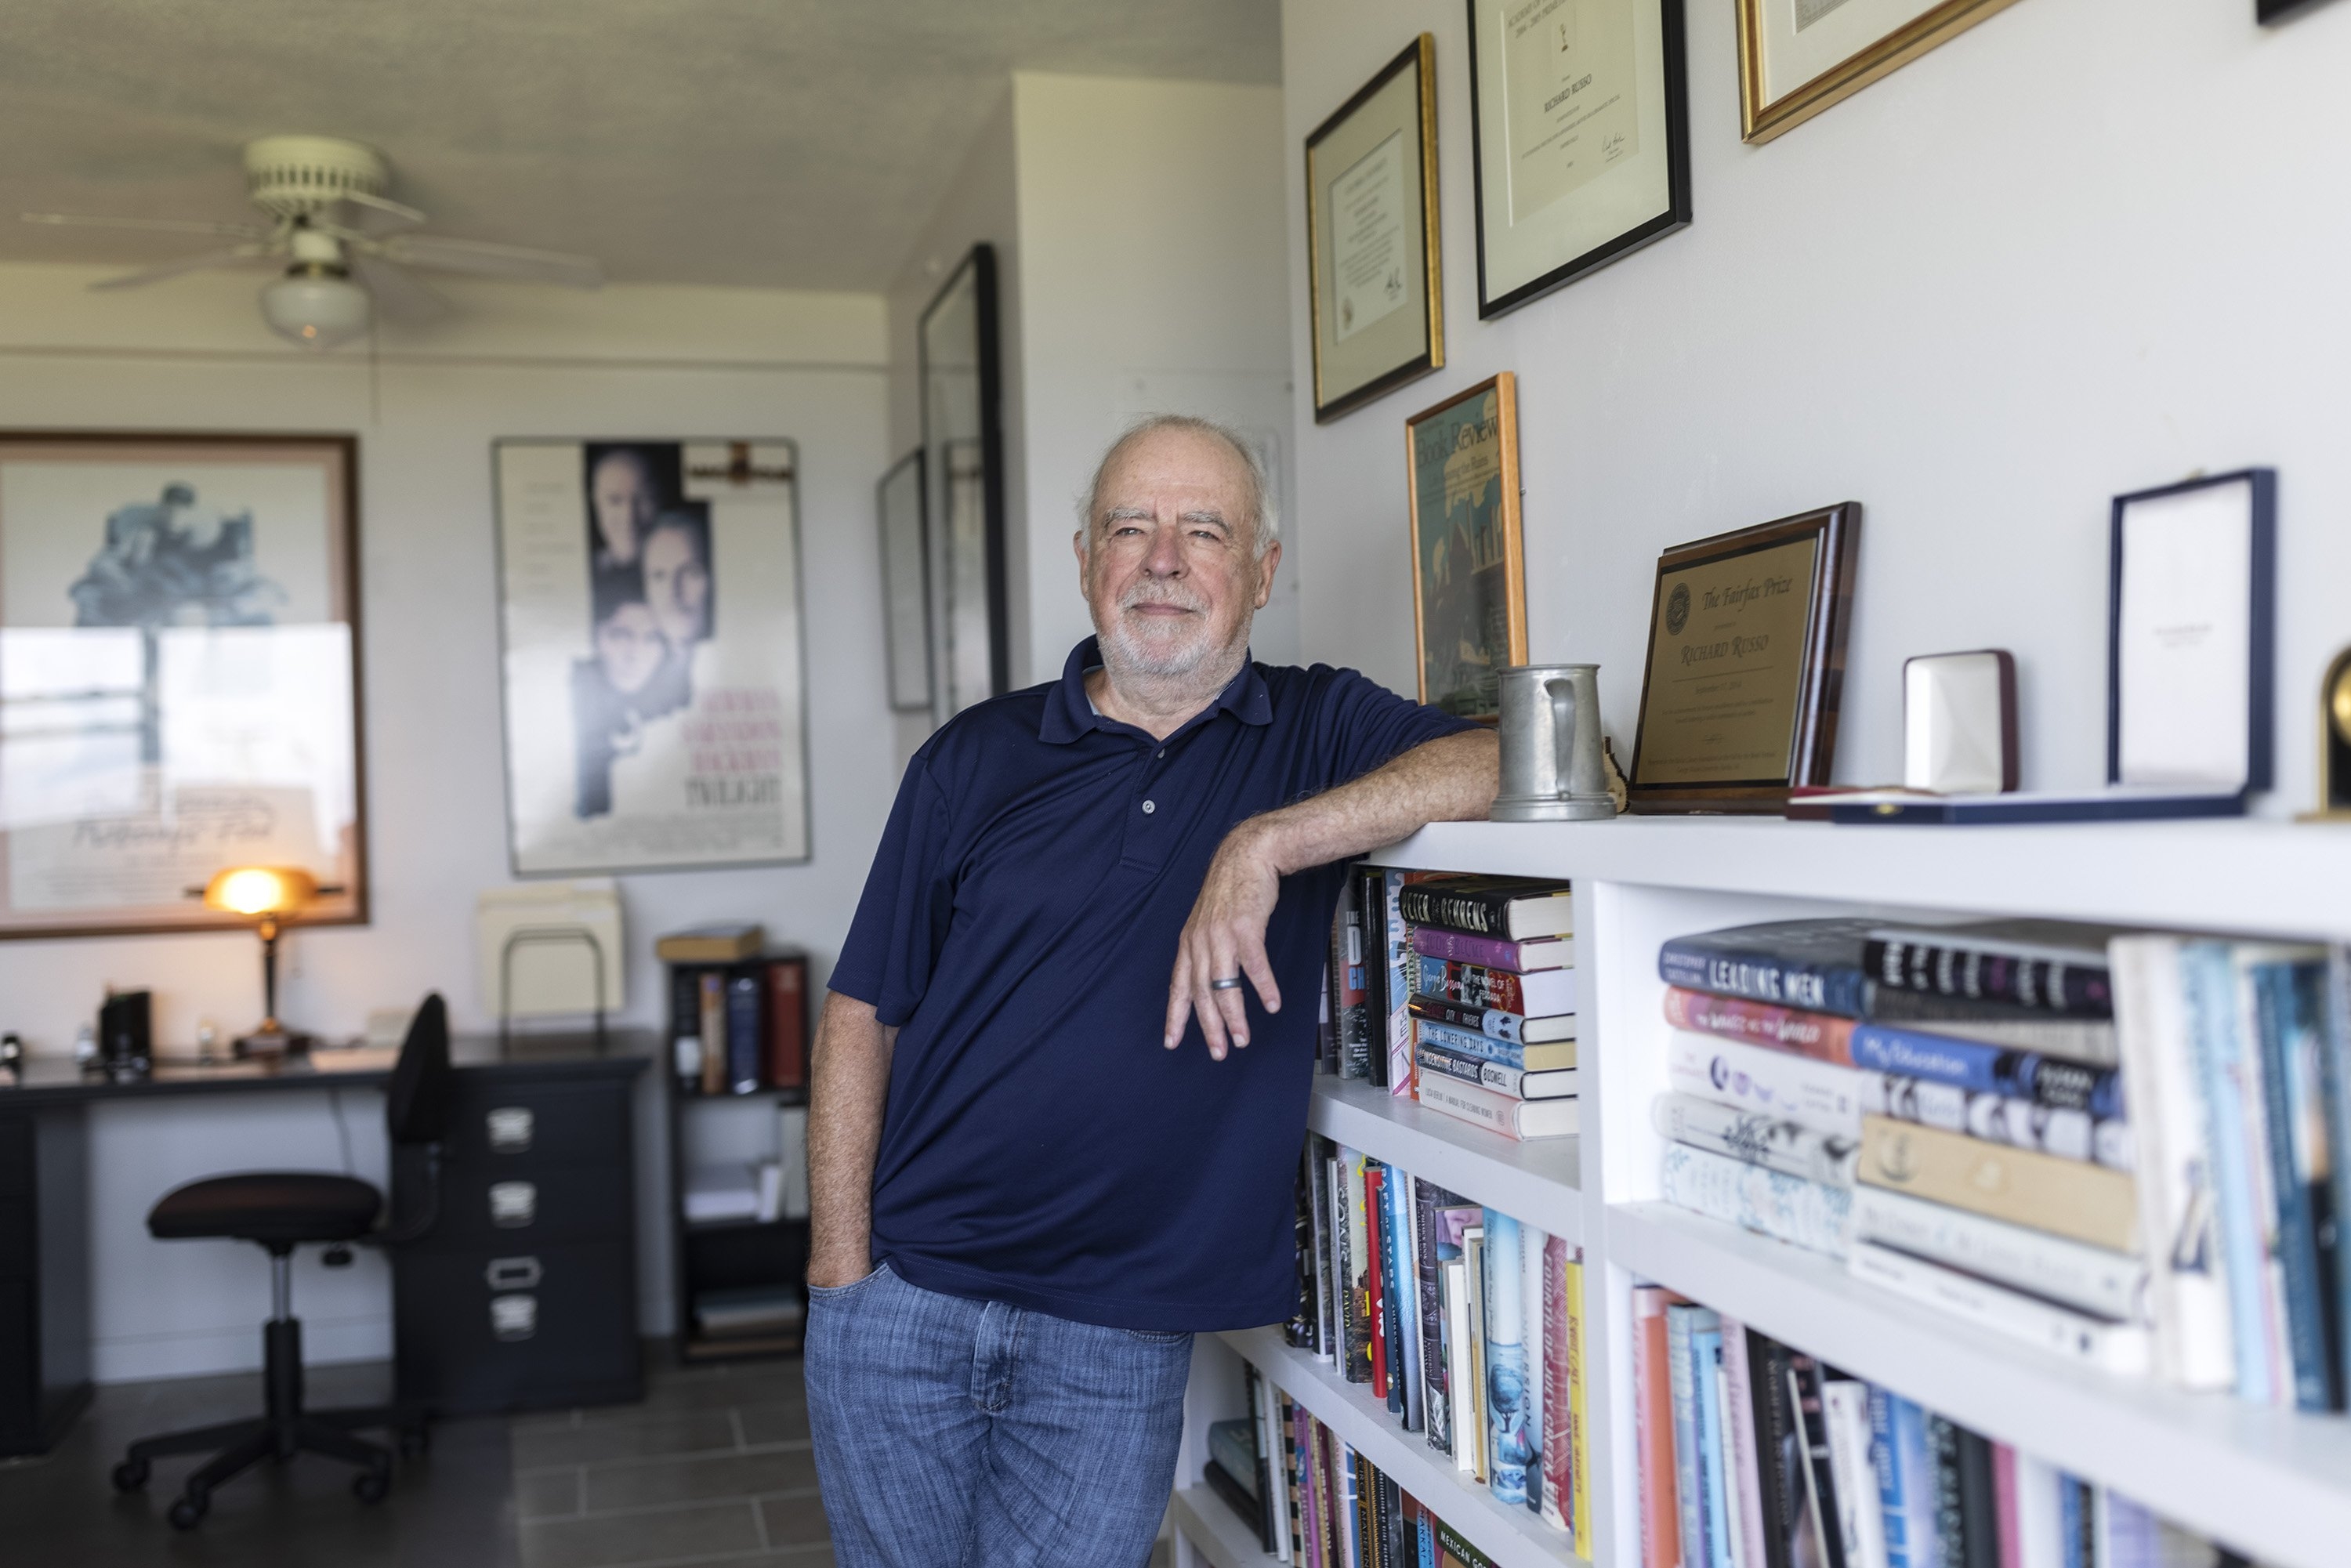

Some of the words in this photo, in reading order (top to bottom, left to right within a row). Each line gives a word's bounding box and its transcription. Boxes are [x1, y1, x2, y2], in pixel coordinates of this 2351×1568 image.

[1702, 586, 1721, 610] The
[1722, 578, 1762, 612] Fairfax
[1762, 575, 1793, 597] Prize
[1680, 642, 1729, 664] RICHARD
[1732, 634, 1770, 658] RUSSO
[1346, 911, 1360, 925] THE
[1402, 892, 1432, 923] PETER
[1440, 897, 1488, 932] BEHRENS
[1708, 958, 1781, 1000] LEADING
[1784, 971, 1825, 1008] MEN
[1428, 1027, 1438, 1039] THE
[1470, 1038, 1484, 1053] DAYS
[1452, 1059, 1479, 1079] BASTARDS
[1483, 1068, 1507, 1087] BOSWELL
[1386, 1235, 1395, 1290] STARS
[1342, 1289, 1351, 1327] DAVID
[1543, 1254, 1554, 1329] FOURTH
[1544, 1332, 1554, 1354] OF
[1544, 1360, 1554, 1412] JULY
[1543, 1414, 1555, 1476] CREEK
[1440, 1530, 1472, 1564] MEXICAN
